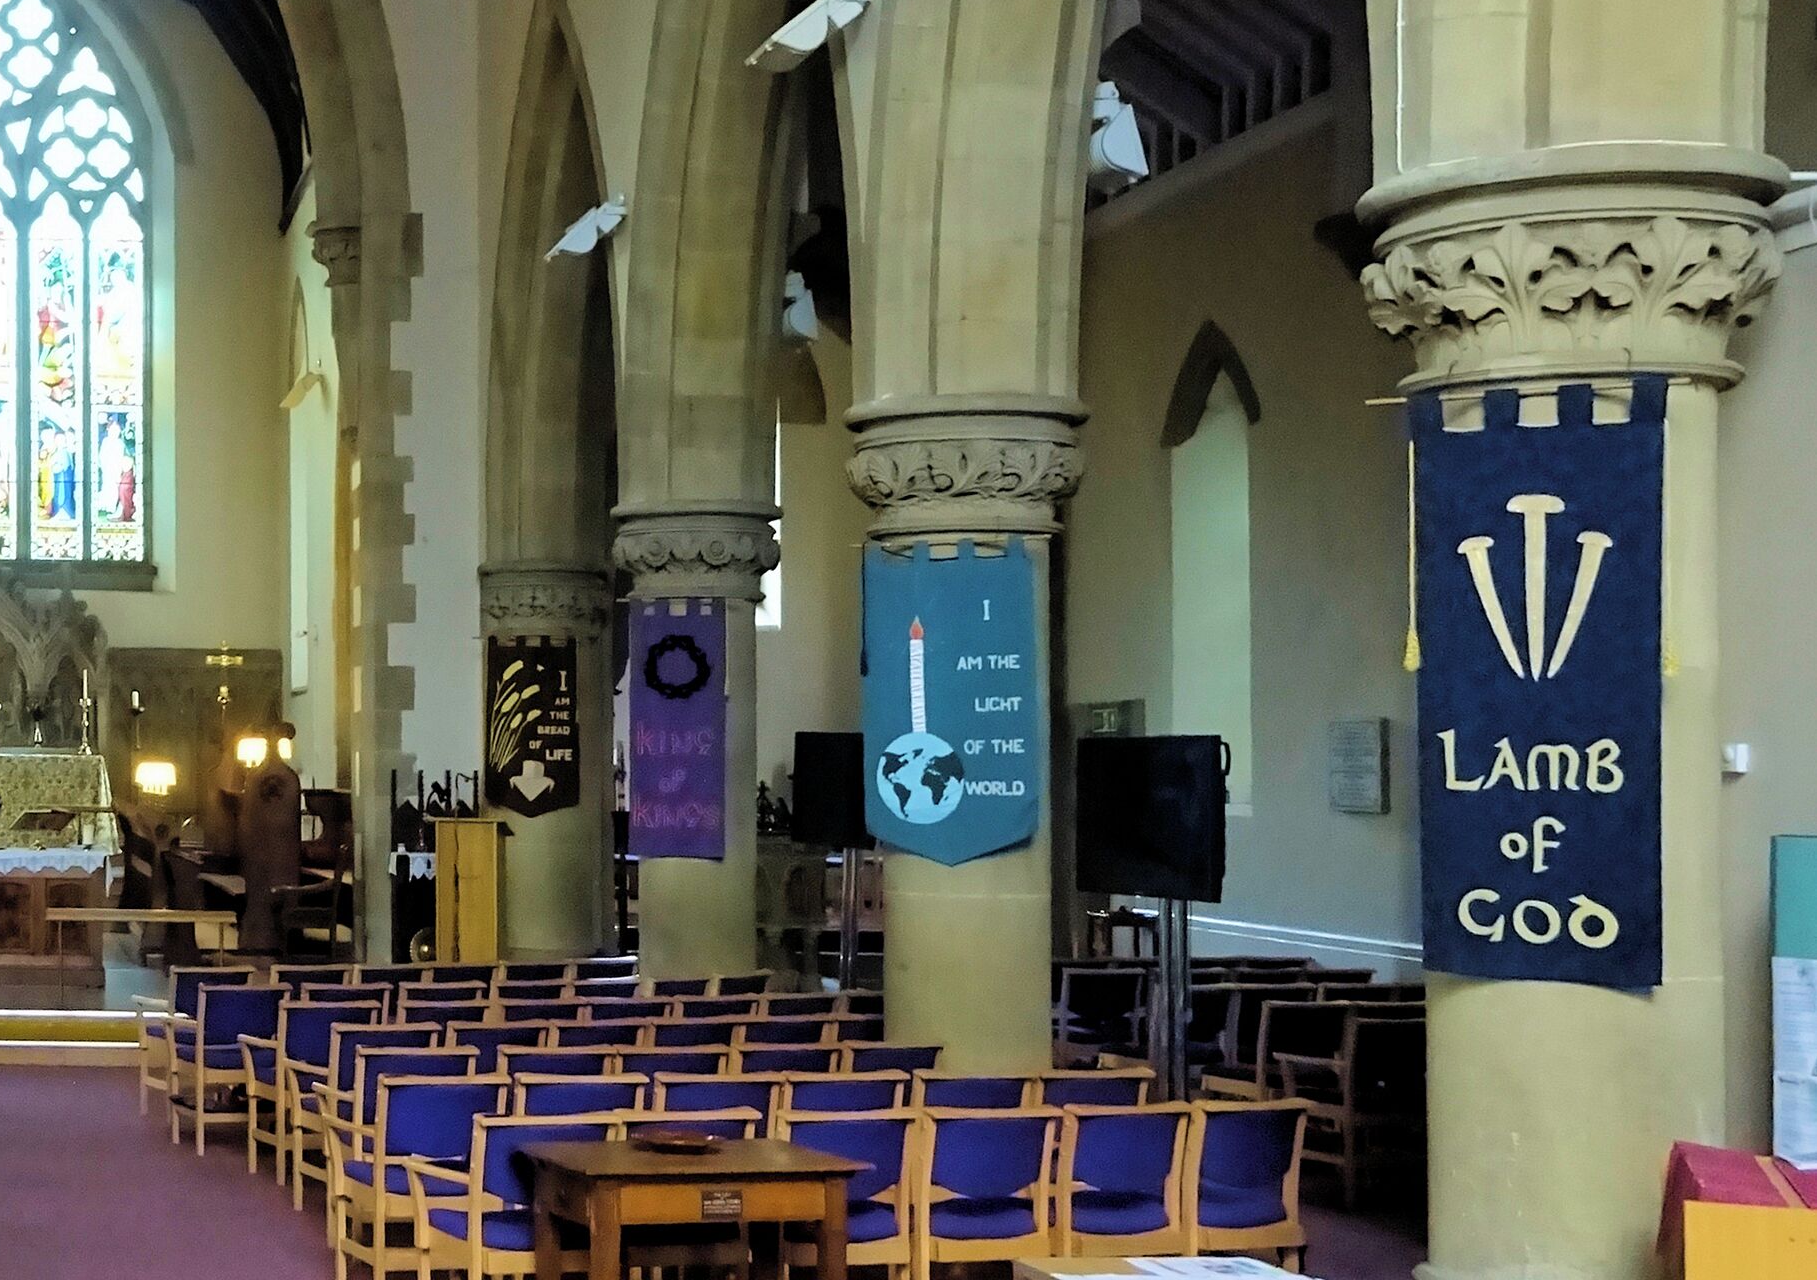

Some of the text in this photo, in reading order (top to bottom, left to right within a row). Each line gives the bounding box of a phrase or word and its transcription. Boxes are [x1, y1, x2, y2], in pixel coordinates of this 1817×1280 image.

[982, 599, 991, 621] I
[956, 654, 1021, 671] AM THE
[558, 670, 568, 692] I
[554, 696, 571, 706] AM
[974, 696, 1023, 712] LIGHT
[549, 710, 570, 720] THE
[537, 725, 571, 736] BREAD
[636, 723, 713, 755] KING
[528, 740, 543, 750] OF
[963, 738, 1025, 755] OF THE
[545, 748, 573, 761] LIFE
[1436, 728, 1625, 793] LAMB
[964, 780, 1025, 796] WORLD
[632, 795, 720, 829] KINGS
[1457, 888, 1620, 950] GOD
